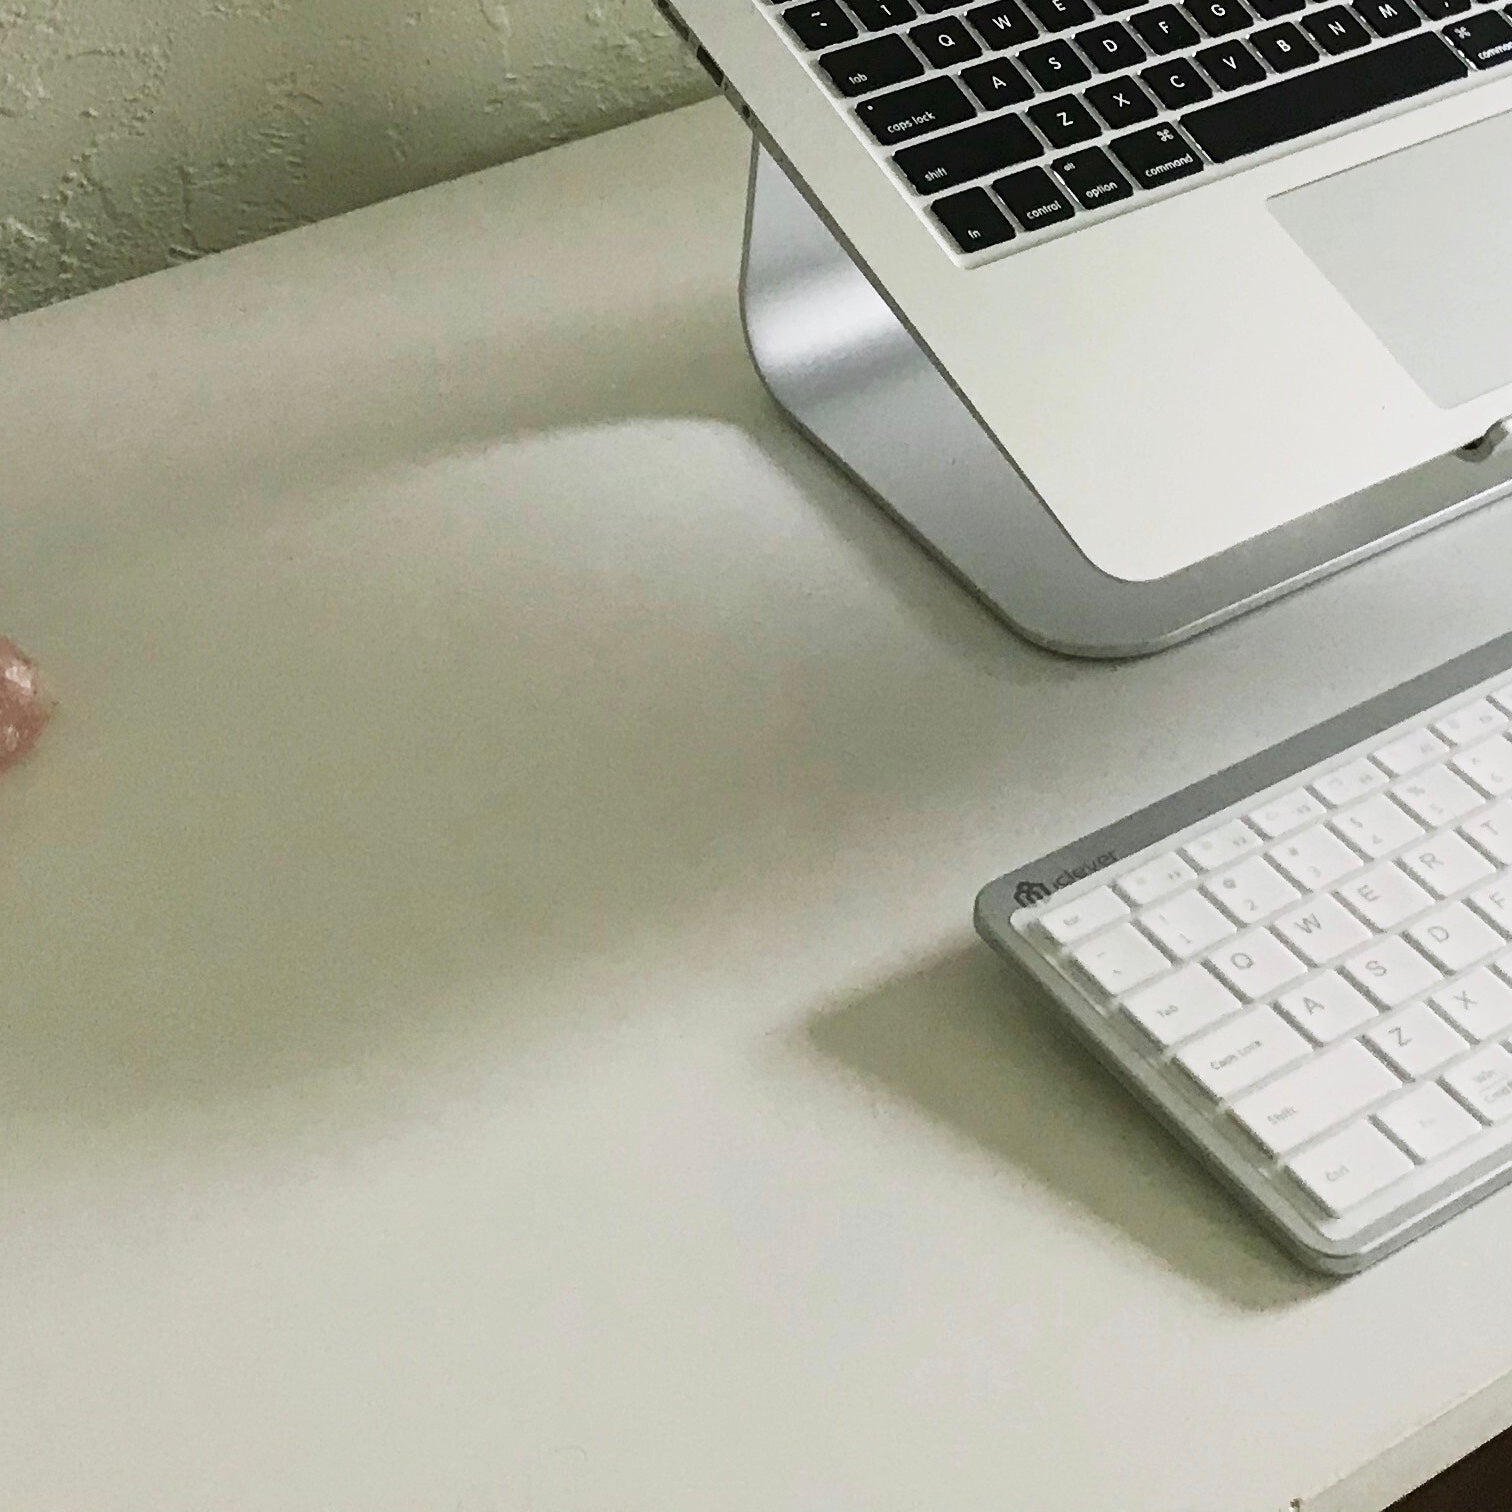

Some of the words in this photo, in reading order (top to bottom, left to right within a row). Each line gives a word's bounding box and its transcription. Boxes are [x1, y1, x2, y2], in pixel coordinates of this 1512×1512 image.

[881, 5, 891, 15] 1
[1052, 0, 1066, 11] E
[1211, 4, 1225, 16] G
[1379, 4, 1397, 18] M
[992, 15, 1011, 29] W
[1159, 21, 1168, 33] F
[1328, 21, 1345, 35] N
[939, 35, 955, 46] Q
[1103, 40, 1117, 52] D
[1277, 40, 1291, 52] B
[1049, 57, 1061, 69] S
[1223, 56, 1236, 69] V
[849, 72, 868, 85] tab
[993, 76, 1006, 89] A
[1170, 76, 1185, 87] C
[1113, 93, 1130, 107] X
[887, 118, 912, 134] caps
[912, 111, 936, 125] lock
[1057, 112, 1073, 126] Z
[1145, 153, 1194, 179] command
[925, 167, 948, 182] shift
[1085, 181, 1119, 199] option
[1027, 200, 1062, 220] control
[967, 228, 981, 239] fn
[1480, 820, 1498, 835] T
[1419, 853, 1444, 869] R
[1357, 885, 1379, 903] E
[1295, 913, 1321, 933] W
[1427, 927, 1449, 943] D
[1231, 953, 1254, 969] Q
[1365, 961, 1387, 976] S
[1303, 997, 1324, 1015] A
[1454, 991, 1477, 1010] X
[1389, 1027, 1411, 1046] Z
